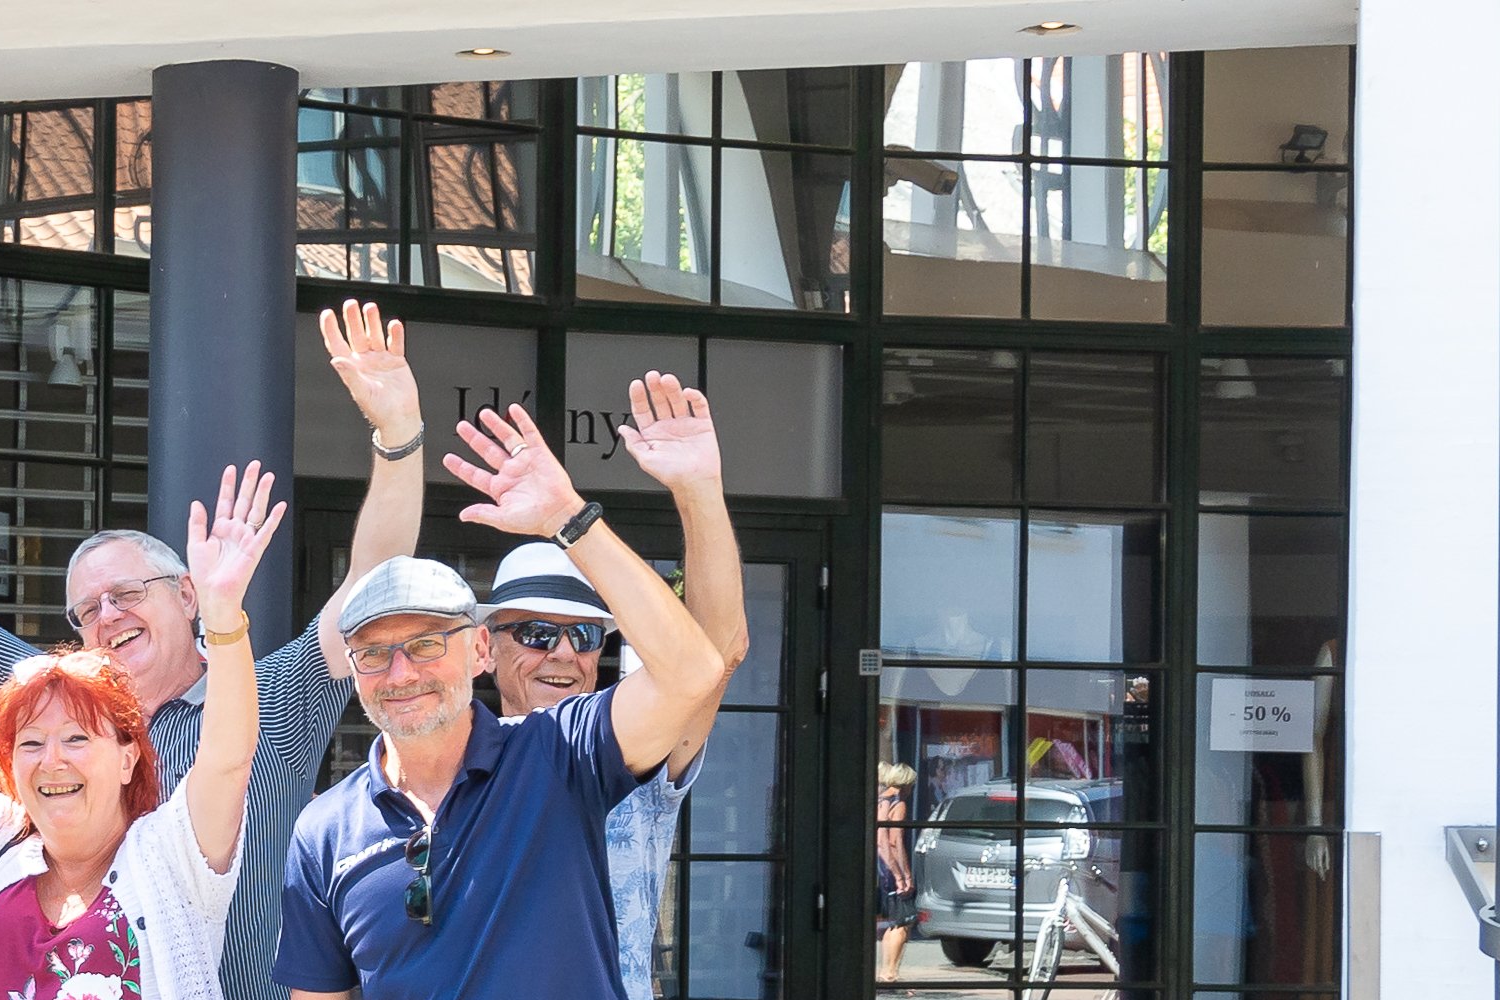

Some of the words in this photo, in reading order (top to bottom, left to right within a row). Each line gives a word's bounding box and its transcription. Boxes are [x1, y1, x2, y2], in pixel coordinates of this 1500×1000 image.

[566, 409, 633, 461] ny
[1243, 705, 1266, 721] 50
[1271, 706, 1291, 722] %
